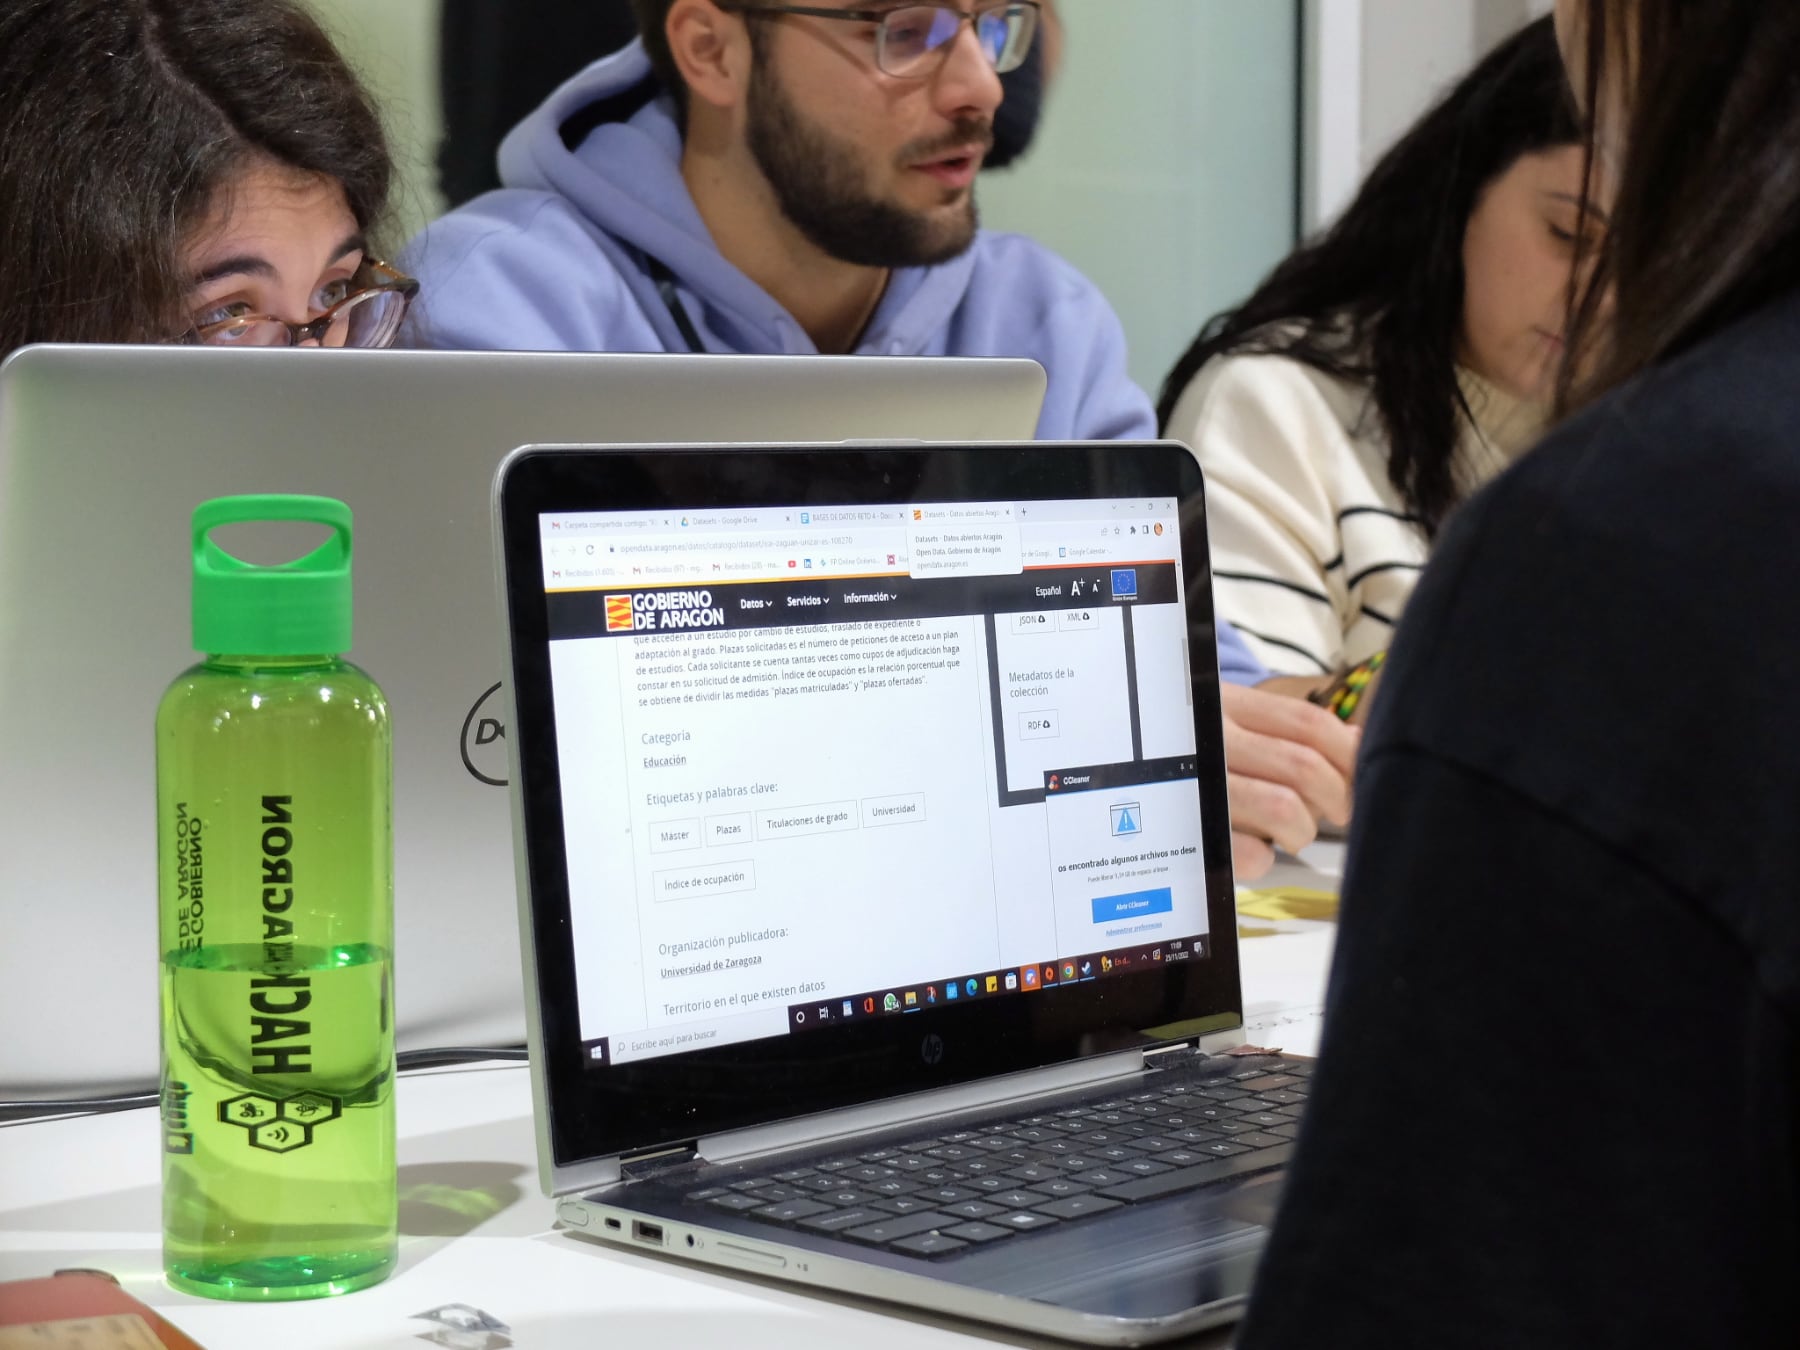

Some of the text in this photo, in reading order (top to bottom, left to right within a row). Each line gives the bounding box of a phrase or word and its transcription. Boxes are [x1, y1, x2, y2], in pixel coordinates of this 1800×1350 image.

[632, 589, 712, 611] GOBIERNO
[843, 591, 889, 603] Información
[1034, 584, 1062, 599] Español
[739, 598, 764, 609] Datos
[786, 594, 821, 607] Servicios
[633, 607, 724, 630] DE ARAGON
[1018, 614, 1037, 626] JSON
[1066, 611, 1081, 621] XML
[632, 635, 650, 646] que
[650, 633, 685, 643] acceden
[686, 633, 692, 641] a
[693, 632, 705, 641] un
[706, 630, 737, 640] estudio
[737, 629, 752, 640] por
[752, 627, 783, 637] cambio
[783, 626, 794, 635] de
[830, 622, 862, 632] traslado
[862, 621, 873, 630] de
[873, 619, 915, 631] expediente
[915, 619, 921, 627] o
[634, 647, 681, 661] adaptación
[681, 647, 690, 657] al
[718, 643, 745, 654] Plazas
[745, 641, 787, 653] solicitadas
[787, 641, 798, 650] es
[798, 639, 806, 649] el
[838, 636, 849, 646] de
[849, 635, 888, 648] peticiones
[888, 633, 899, 643] de
[899, 633, 925, 642] acceso
[924, 632, 931, 641] a
[930, 632, 942, 640] un
[942, 630, 959, 642] plan
[635, 665, 646, 675] de
[686, 661, 708, 672] Cada
[708, 659, 751, 671] solicitante
[751, 658, 762, 667] se
[762, 656, 790, 666] cuenta
[790, 655, 816, 665] tantas
[816, 653, 839, 663] veces
[838, 652, 861, 661] como
[861, 650, 884, 661] cupos
[884, 648, 895, 658] de
[895, 645, 941, 659] adjudicación
[941, 644, 960, 656] haga
[636, 681, 668, 691] constar
[669, 679, 681, 689] en
[681, 679, 692, 688] su
[693, 674, 729, 687] solicitud
[728, 674, 740, 684] de
[805, 669, 816, 678] de
[816, 665, 856, 679] ocupación
[856, 666, 867, 675] es
[866, 663, 875, 674] la
[905, 658, 946, 673] porcentual
[945, 659, 960, 670] que
[1008, 667, 1074, 683] Metadatos de la
[637, 698, 648, 707] se
[648, 695, 681, 706] obtiene
[682, 693, 694, 703] de
[694, 690, 720, 702] dividir
[721, 690, 734, 700] las
[735, 687, 769, 698] medidas
[852, 681, 859, 692] y
[1009, 684, 1049, 698] colección
[1027, 719, 1041, 730] RDF
[642, 753, 687, 768] Educación
[1062, 775, 1090, 785] CCleaner
[645, 781, 778, 807] Etiquetas y palabras clave:
[871, 802, 916, 817] Universidad
[766, 810, 848, 829] Titulaciones de grado
[715, 824, 741, 835] Plazas
[1057, 844, 1196, 873] os encontrado algunos archivos no dese
[690, 876, 702, 887] de
[702, 871, 745, 886] ocupación
[657, 927, 788, 957] Organización publicadora:
[660, 955, 762, 978] Universidad de Zaragoza
[662, 980, 826, 1016] Territorio en el que existen datos
[630, 1039, 657, 1052] Escribe
[675, 1033, 693, 1045] para
[693, 1029, 717, 1041] buscar
